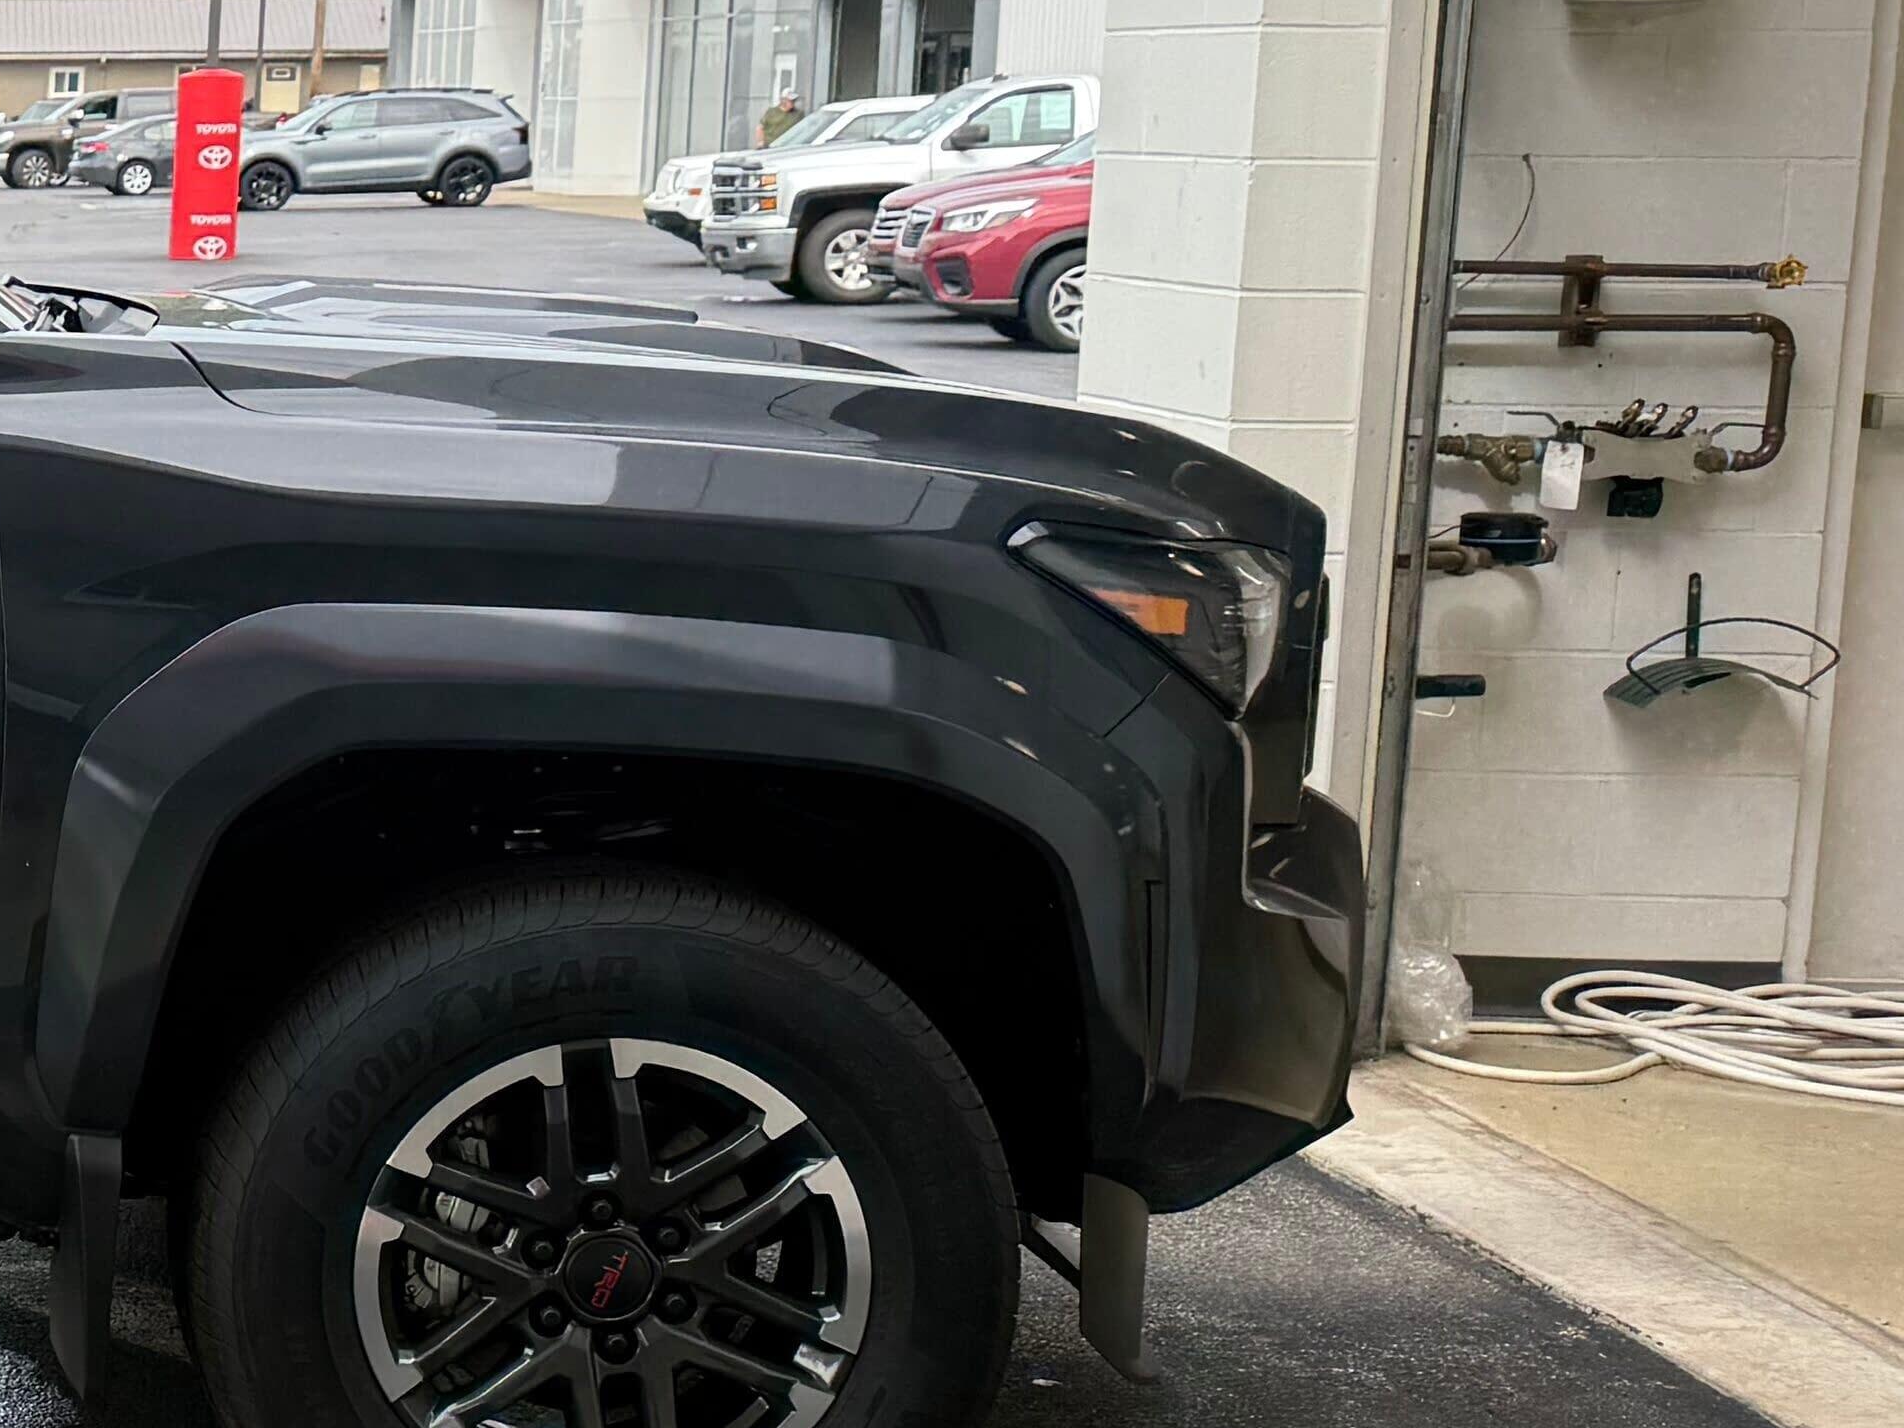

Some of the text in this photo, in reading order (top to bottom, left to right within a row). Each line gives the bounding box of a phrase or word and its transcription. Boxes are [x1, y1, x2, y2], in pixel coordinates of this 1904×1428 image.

[196, 123, 237, 135] TOYOTA
[190, 214, 233, 226] TOYOTA
[591, 1250, 630, 1309] TRD
